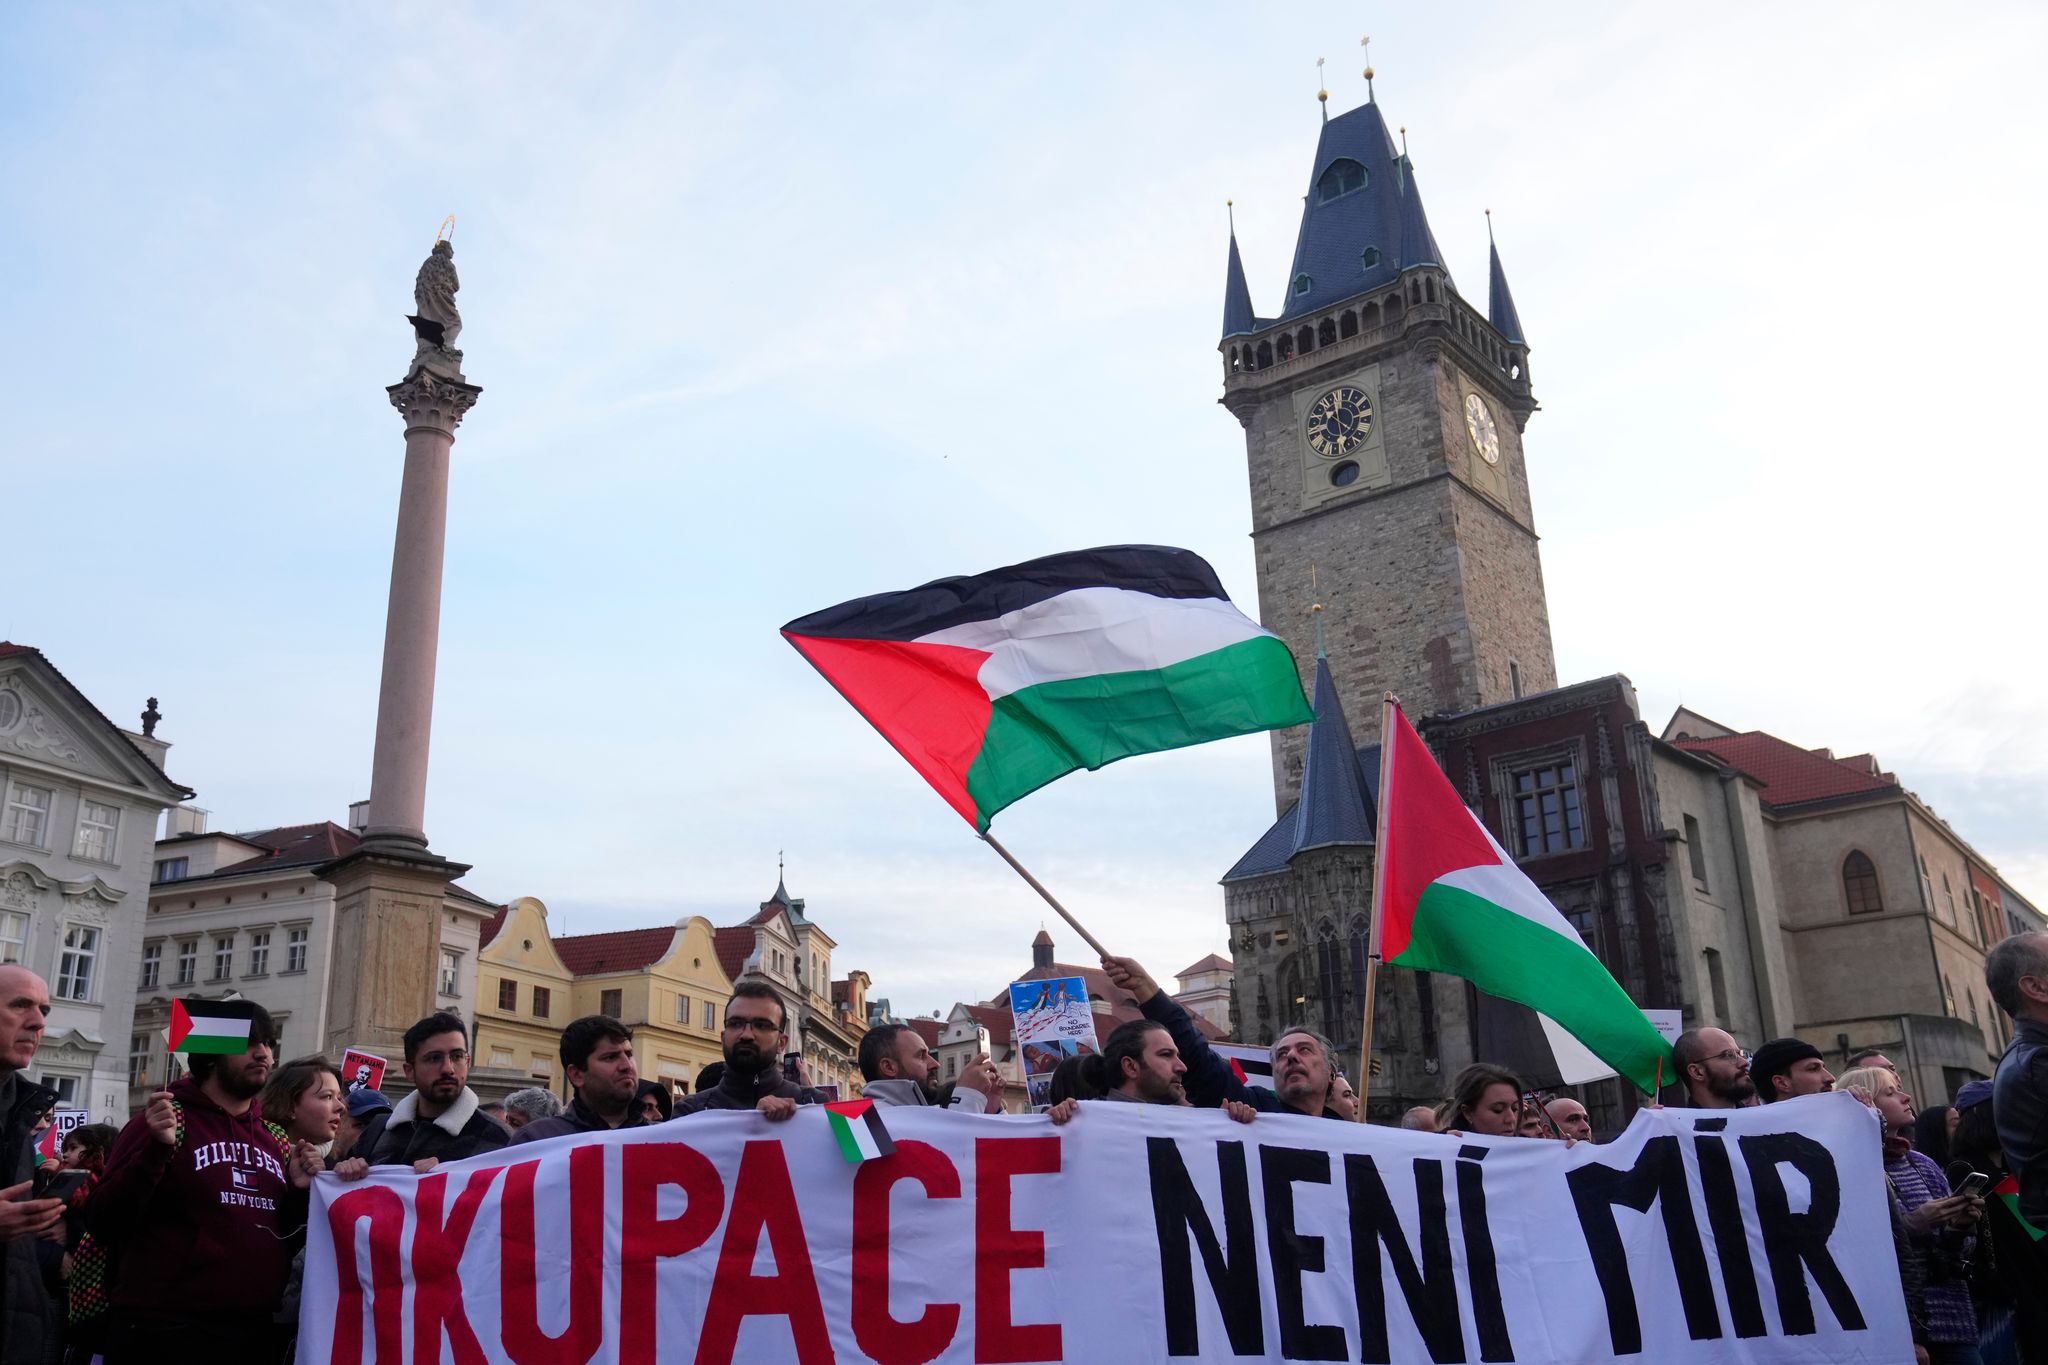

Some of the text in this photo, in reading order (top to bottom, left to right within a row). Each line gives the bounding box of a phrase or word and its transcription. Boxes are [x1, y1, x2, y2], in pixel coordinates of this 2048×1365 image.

[53, 1113, 85, 1129] IDÉ
[328, 1118, 1868, 1365] OKUPACE NENÍ MÍR
